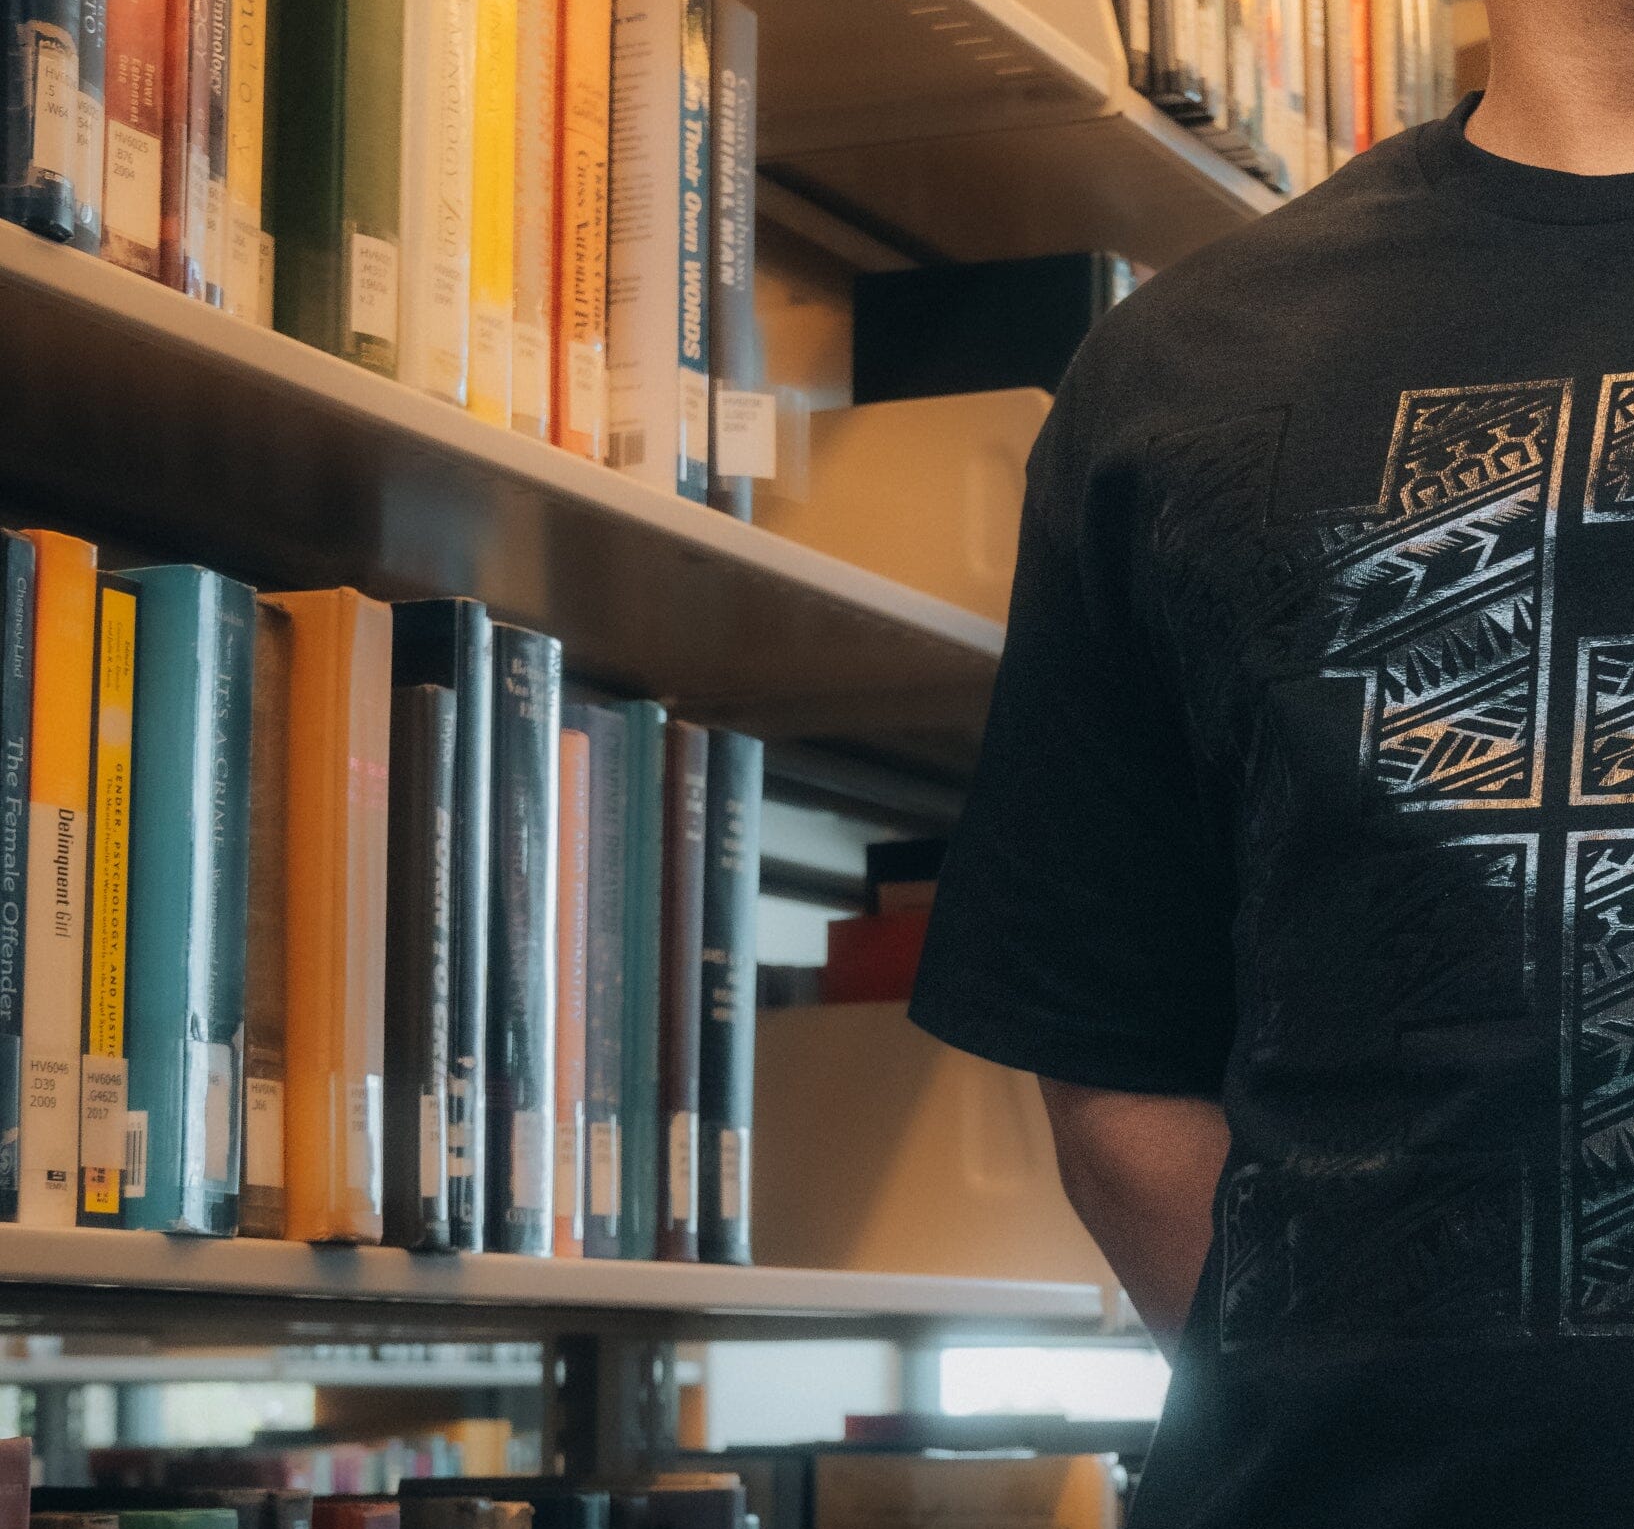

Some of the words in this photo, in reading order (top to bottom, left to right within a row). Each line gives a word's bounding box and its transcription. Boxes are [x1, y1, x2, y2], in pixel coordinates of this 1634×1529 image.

[85, 0, 99, 34] TO
[143, 63, 156, 107] Brown
[685, 117, 703, 188] Their
[719, 68, 737, 213] CRIMINAL
[683, 192, 702, 253] Own
[718, 218, 736, 287] MAN
[682, 259, 702, 360] WORDS
[12, 577, 28, 678] Chesney-Lind
[5, 738, 25, 786] The
[214, 729, 229, 744] A
[113, 762, 123, 832] GENDER,
[212, 757, 229, 849] CRIME
[3, 795, 24, 892] Female
[54, 807, 75, 906] Delinquent
[55, 911, 73, 939] Girl
[110, 840, 121, 956] PSYCHOLOGY,
[1, 901, 20, 1022] Offender
[108, 964, 118, 997] AND
[106, 1003, 117, 1059] JUSTIC
[30, 1077, 56, 1091] .D39
[30, 1095, 57, 1109] 2009
[87, 1072, 122, 1086] HV6046
[87, 1107, 110, 1120] 2017
